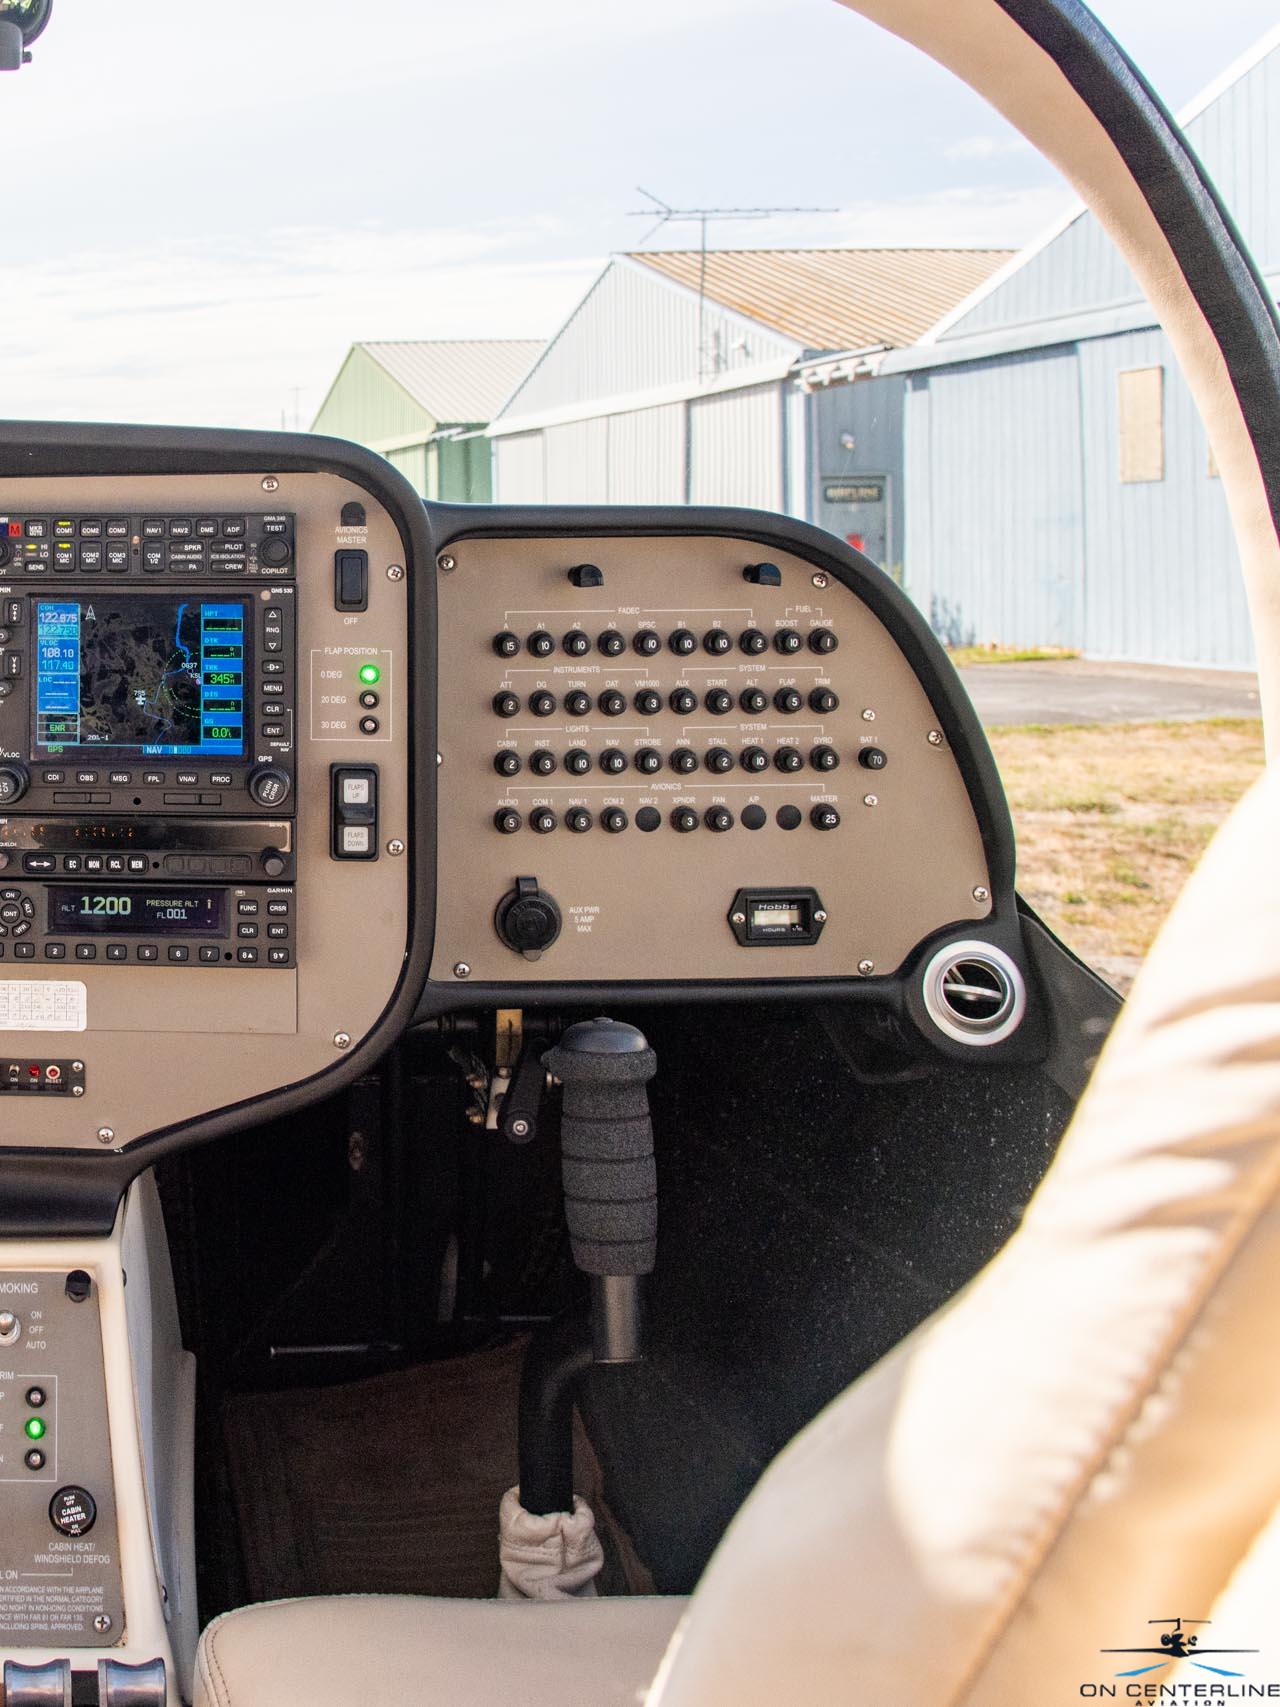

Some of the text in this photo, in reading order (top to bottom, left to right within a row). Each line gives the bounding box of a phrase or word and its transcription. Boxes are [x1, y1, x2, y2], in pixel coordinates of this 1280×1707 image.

[146, 526, 162, 534] NAV1
[199, 525, 214, 533] DME
[266, 524, 283, 532] TEST
[224, 543, 243, 551] PILOT
[224, 562, 243, 570] CREW
[261, 567, 288, 575] COPILOT
[40, 613, 77, 623] 122.975
[707, 679, 727, 687] START
[263, 684, 283, 692] MENU
[266, 705, 280, 713] CLR
[569, 739, 586, 747] LAND
[635, 738, 661, 746] STROBE
[258, 755, 273, 763] GPS
[147, 775, 160, 783] FPL
[178, 775, 197, 783] VNAV
[826, 814, 836, 823] 25
[5, 891, 16, 899] ON
[81, 897, 130, 914] 1200
[146, 900, 198, 908] PRESSURE ALT
[239, 904, 257, 912] FUNC
[269, 904, 287, 912] CRSR
[758, 903, 798, 911] Hobbs
[3, 910, 18, 918] IDNT
[271, 927, 285, 935] ENT
[26, 1341, 46, 1349] AUTO
[60, 1513, 86, 1524] HEATER
[35, 1555, 110, 1563] WINDSHIELD DEFOG
[5, 1571, 17, 1579] ON
